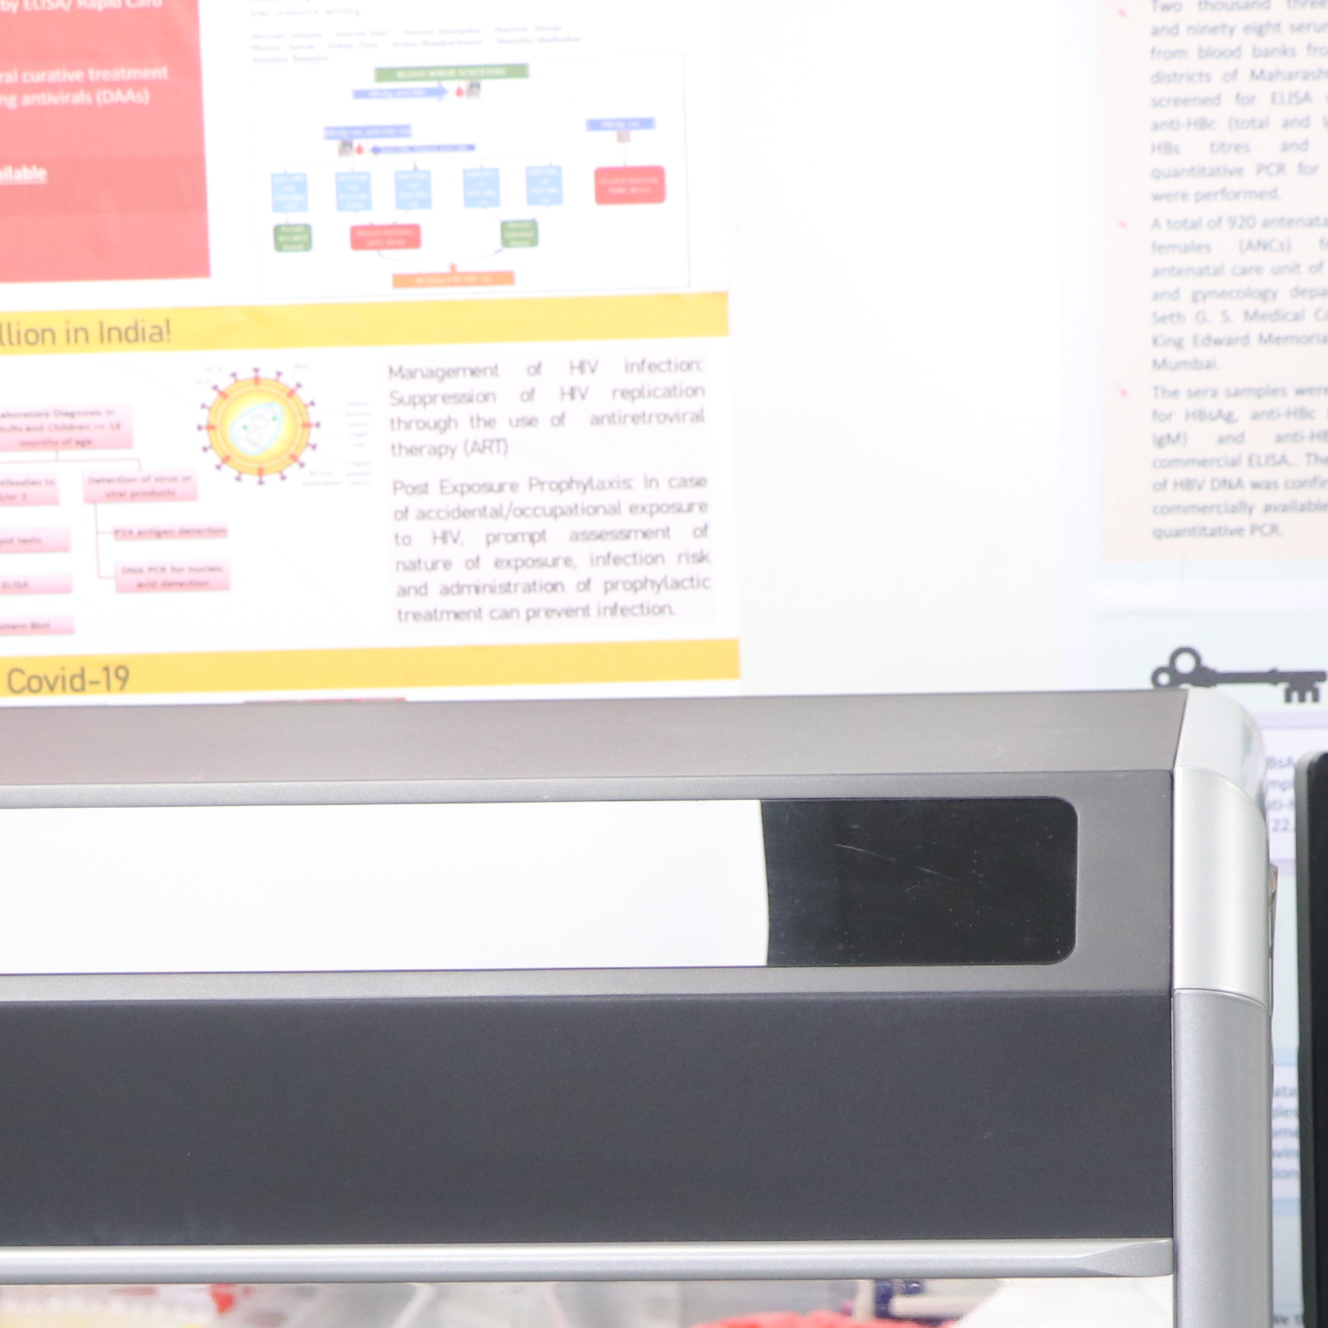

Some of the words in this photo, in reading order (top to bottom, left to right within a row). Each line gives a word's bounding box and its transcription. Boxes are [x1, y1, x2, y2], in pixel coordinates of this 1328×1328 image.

[21, 68, 84, 83] curative
[87, 66, 169, 81] treatment
[21, 89, 92, 106] antivirals
[64, 319, 90, 348] in
[96, 316, 176, 346] India!
[387, 364, 498, 382] Management
[526, 360, 542, 376] of
[569, 359, 598, 374] HIV
[388, 390, 496, 408] Suppression
[520, 386, 535, 402] of
[559, 385, 588, 401] HIV
[611, 384, 705, 402] replication
[6, 663, 133, 695] Covid-19
